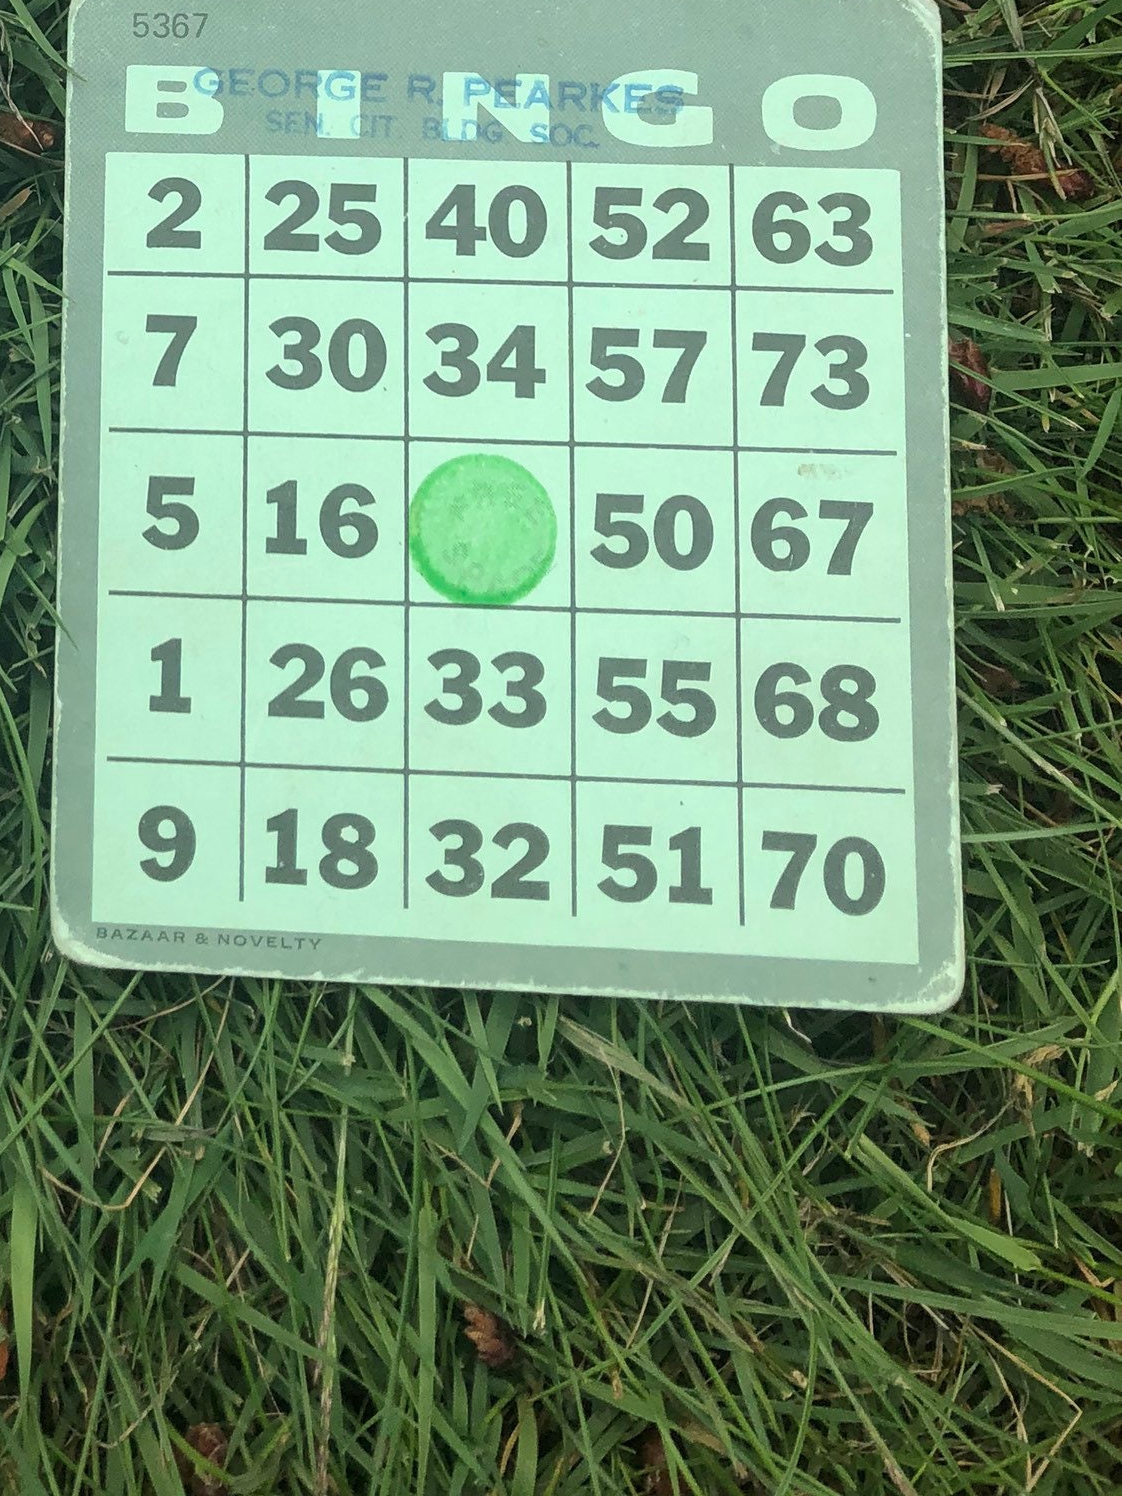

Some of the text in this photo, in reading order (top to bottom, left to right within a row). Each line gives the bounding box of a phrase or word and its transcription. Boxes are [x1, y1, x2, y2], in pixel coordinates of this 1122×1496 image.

[132, 12, 208, 39] 5367
[192, 66, 390, 105] GEORGE
[463, 76, 685, 117] PEARKES
[147, 177, 873, 266] 2 25 40 52 63
[146, 315, 869, 410] 7 30 34 57 73
[142, 476, 199, 550] 5
[266, 480, 378, 558] 16
[590, 493, 713, 570] 50
[751, 498, 873, 575] 67
[149, 638, 879, 742] 1 26 33 55 68
[138, 806, 885, 916] 9 18 32 51 70
[95, 926, 323, 951] BAZAAR & NOVELTY
